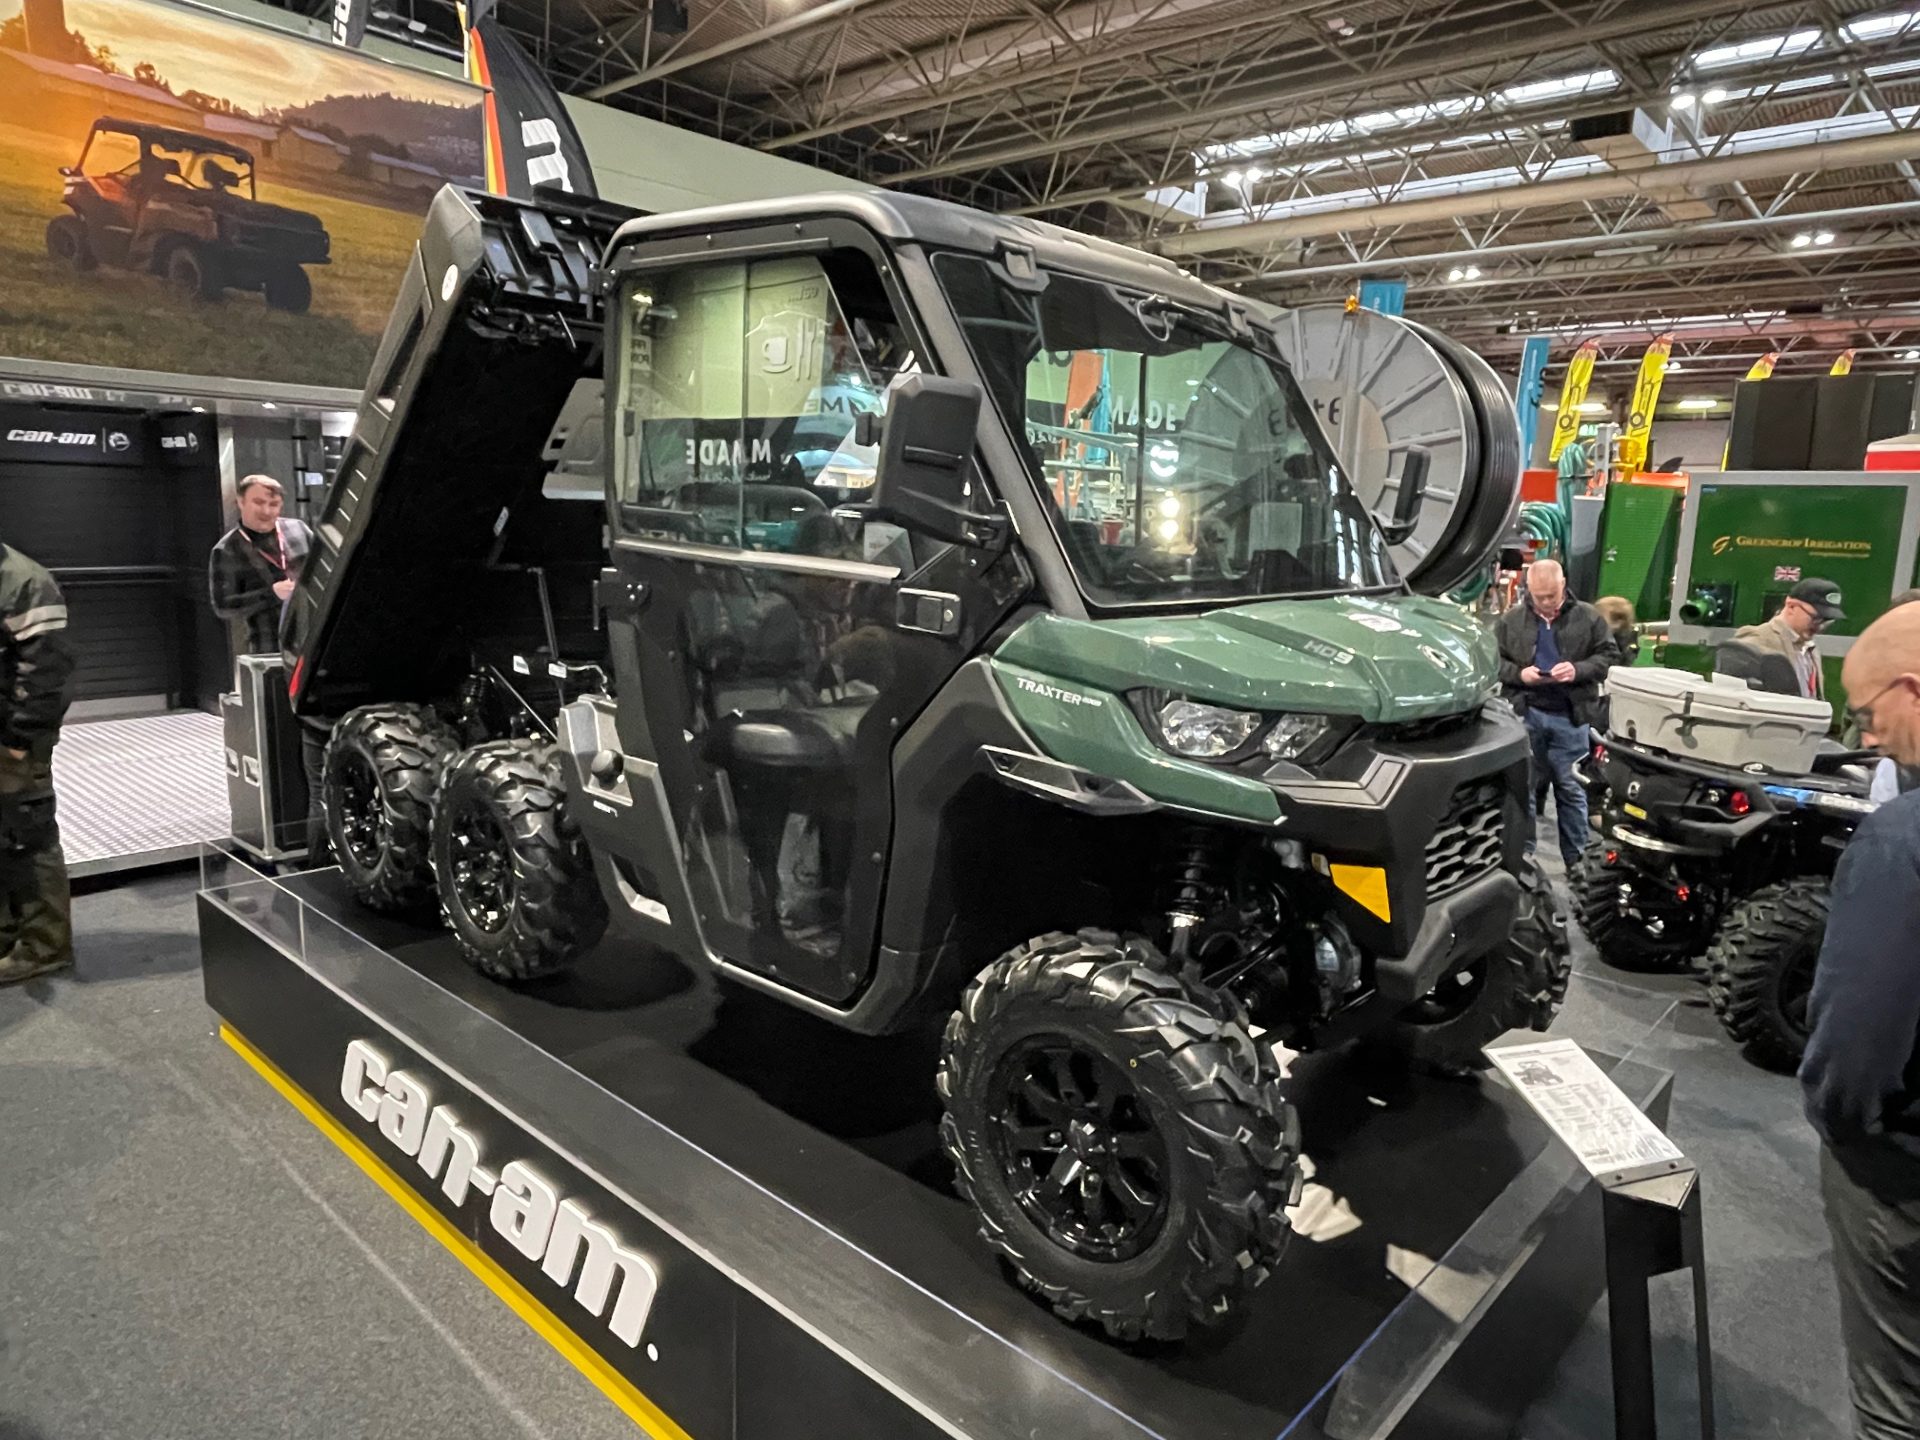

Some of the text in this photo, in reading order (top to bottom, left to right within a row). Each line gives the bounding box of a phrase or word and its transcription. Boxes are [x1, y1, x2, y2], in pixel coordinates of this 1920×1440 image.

[7, 429, 96, 445] can-am
[1017, 677, 1082, 706] TRAXTER
[341, 1040, 657, 1349] can-am
